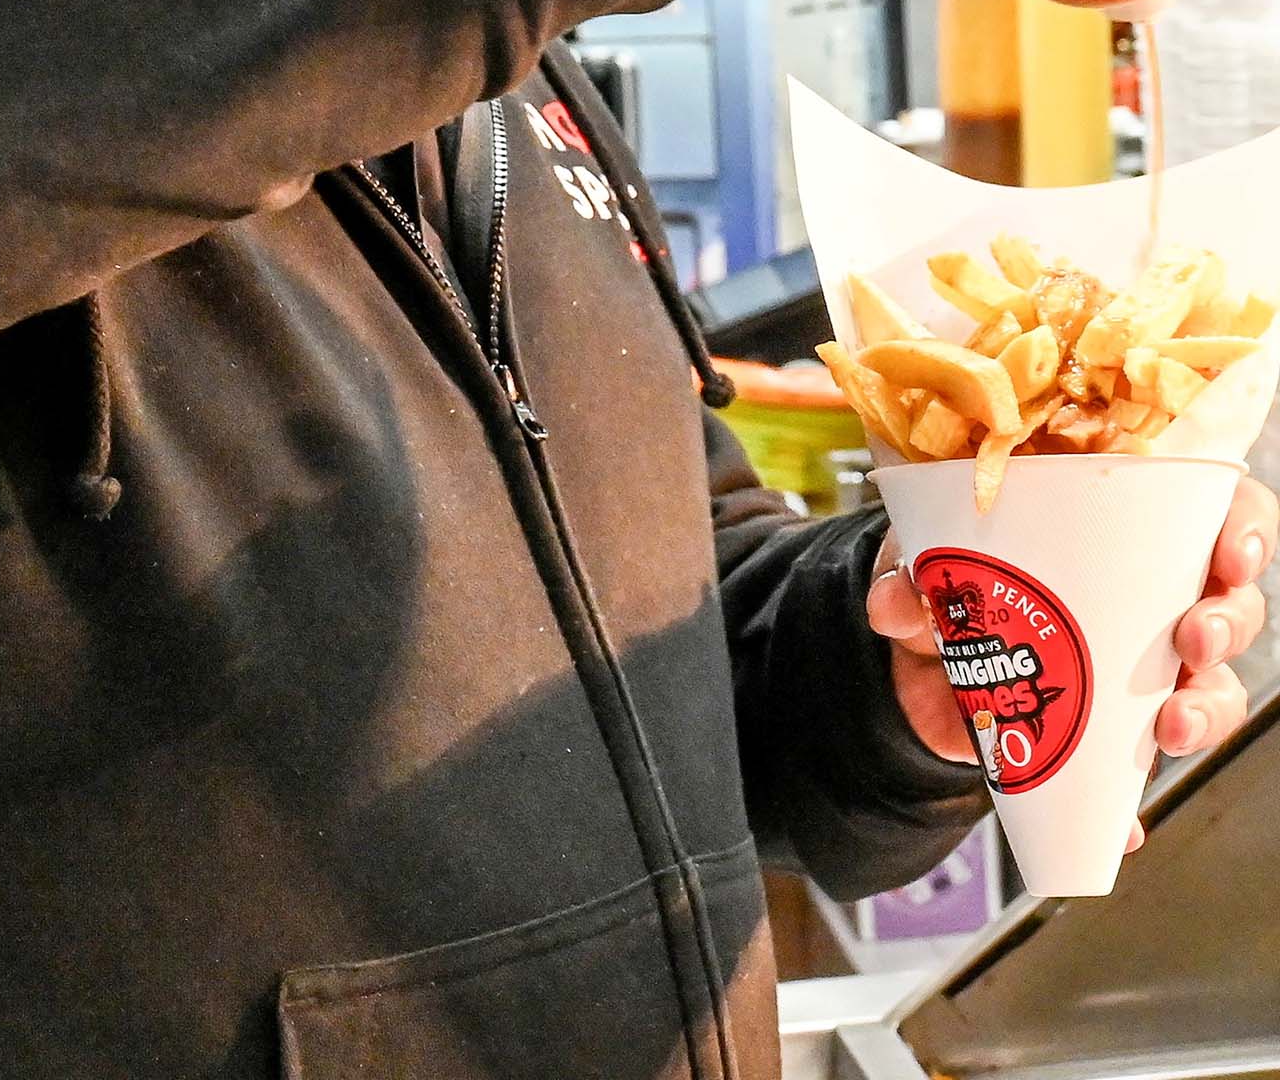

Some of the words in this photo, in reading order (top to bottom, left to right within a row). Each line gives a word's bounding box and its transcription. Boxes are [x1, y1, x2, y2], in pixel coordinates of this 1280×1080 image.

[987, 608, 1010, 625] 20
[992, 581, 1057, 641] PENCE
[977, 640, 1002, 654] DAYS
